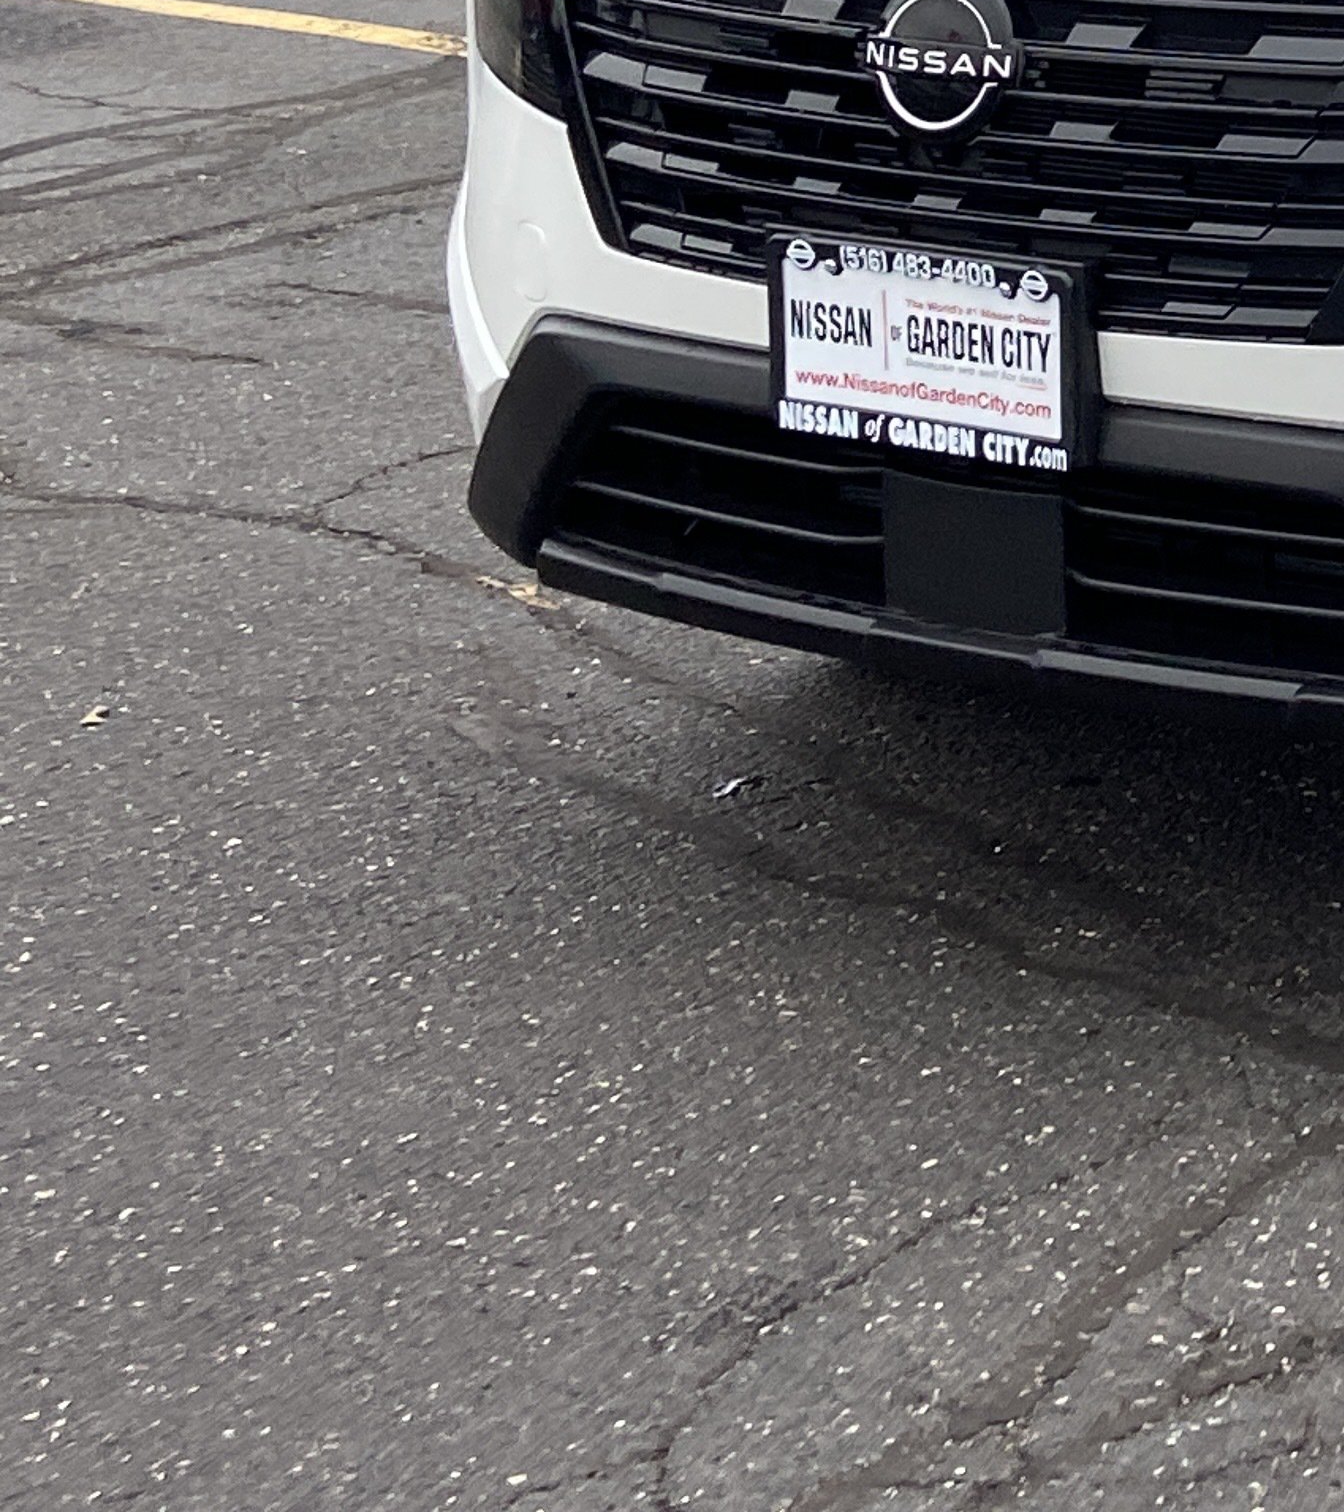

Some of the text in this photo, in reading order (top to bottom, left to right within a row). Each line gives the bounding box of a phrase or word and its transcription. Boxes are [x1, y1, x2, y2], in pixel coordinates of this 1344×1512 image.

[866, 40, 1012, 79] NISSAN
[840, 245, 996, 289] (516) 483-4400
[790, 298, 873, 348] NISSAN
[907, 314, 995, 365] GARDEN
[1001, 327, 1052, 374] CITY
[795, 370, 1052, 419] www.NissanofGardenCity.com
[779, 400, 1068, 472] NISSAN of GARDEN CITY.com
